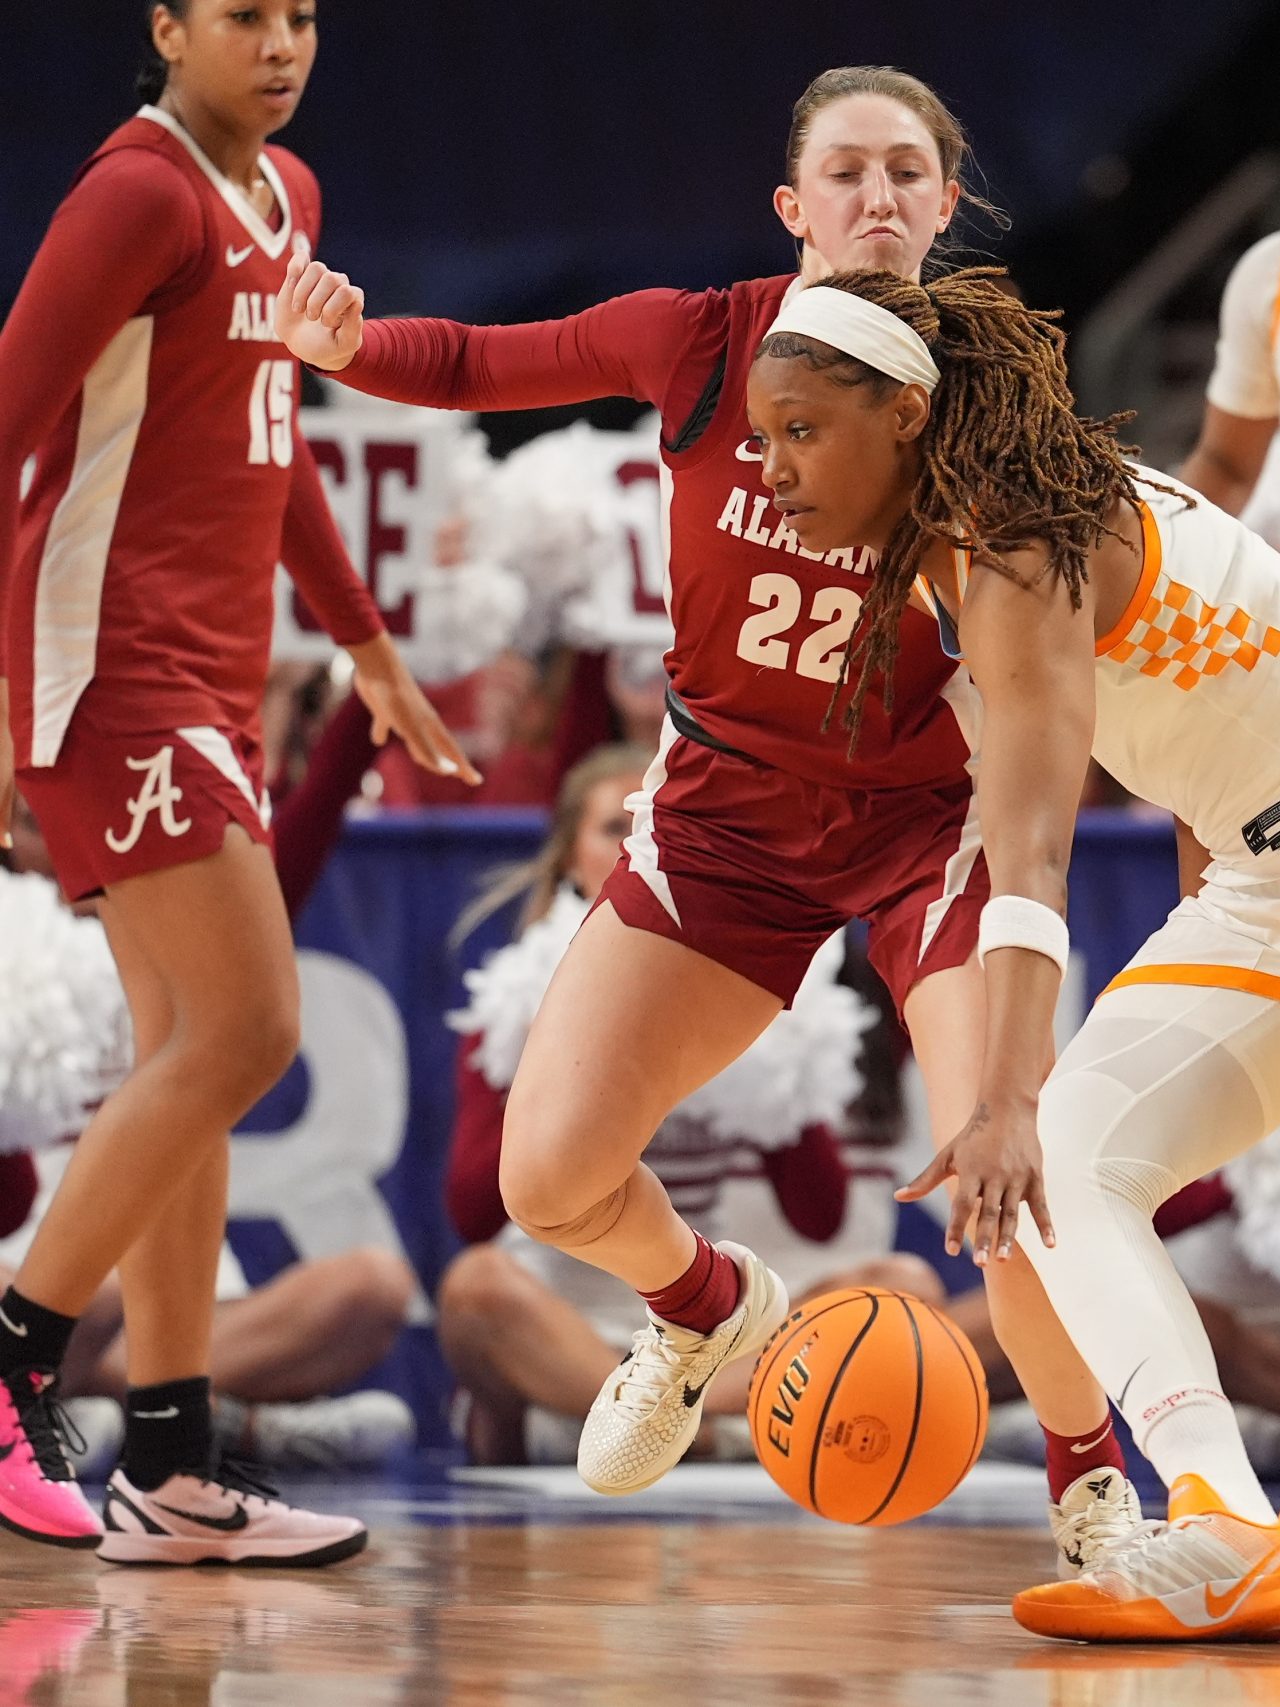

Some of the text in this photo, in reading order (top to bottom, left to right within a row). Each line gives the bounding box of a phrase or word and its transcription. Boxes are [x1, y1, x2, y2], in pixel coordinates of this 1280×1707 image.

[247, 359, 294, 469] 15
[736, 572, 864, 685] 22
[768, 1355, 812, 1458] EVO
